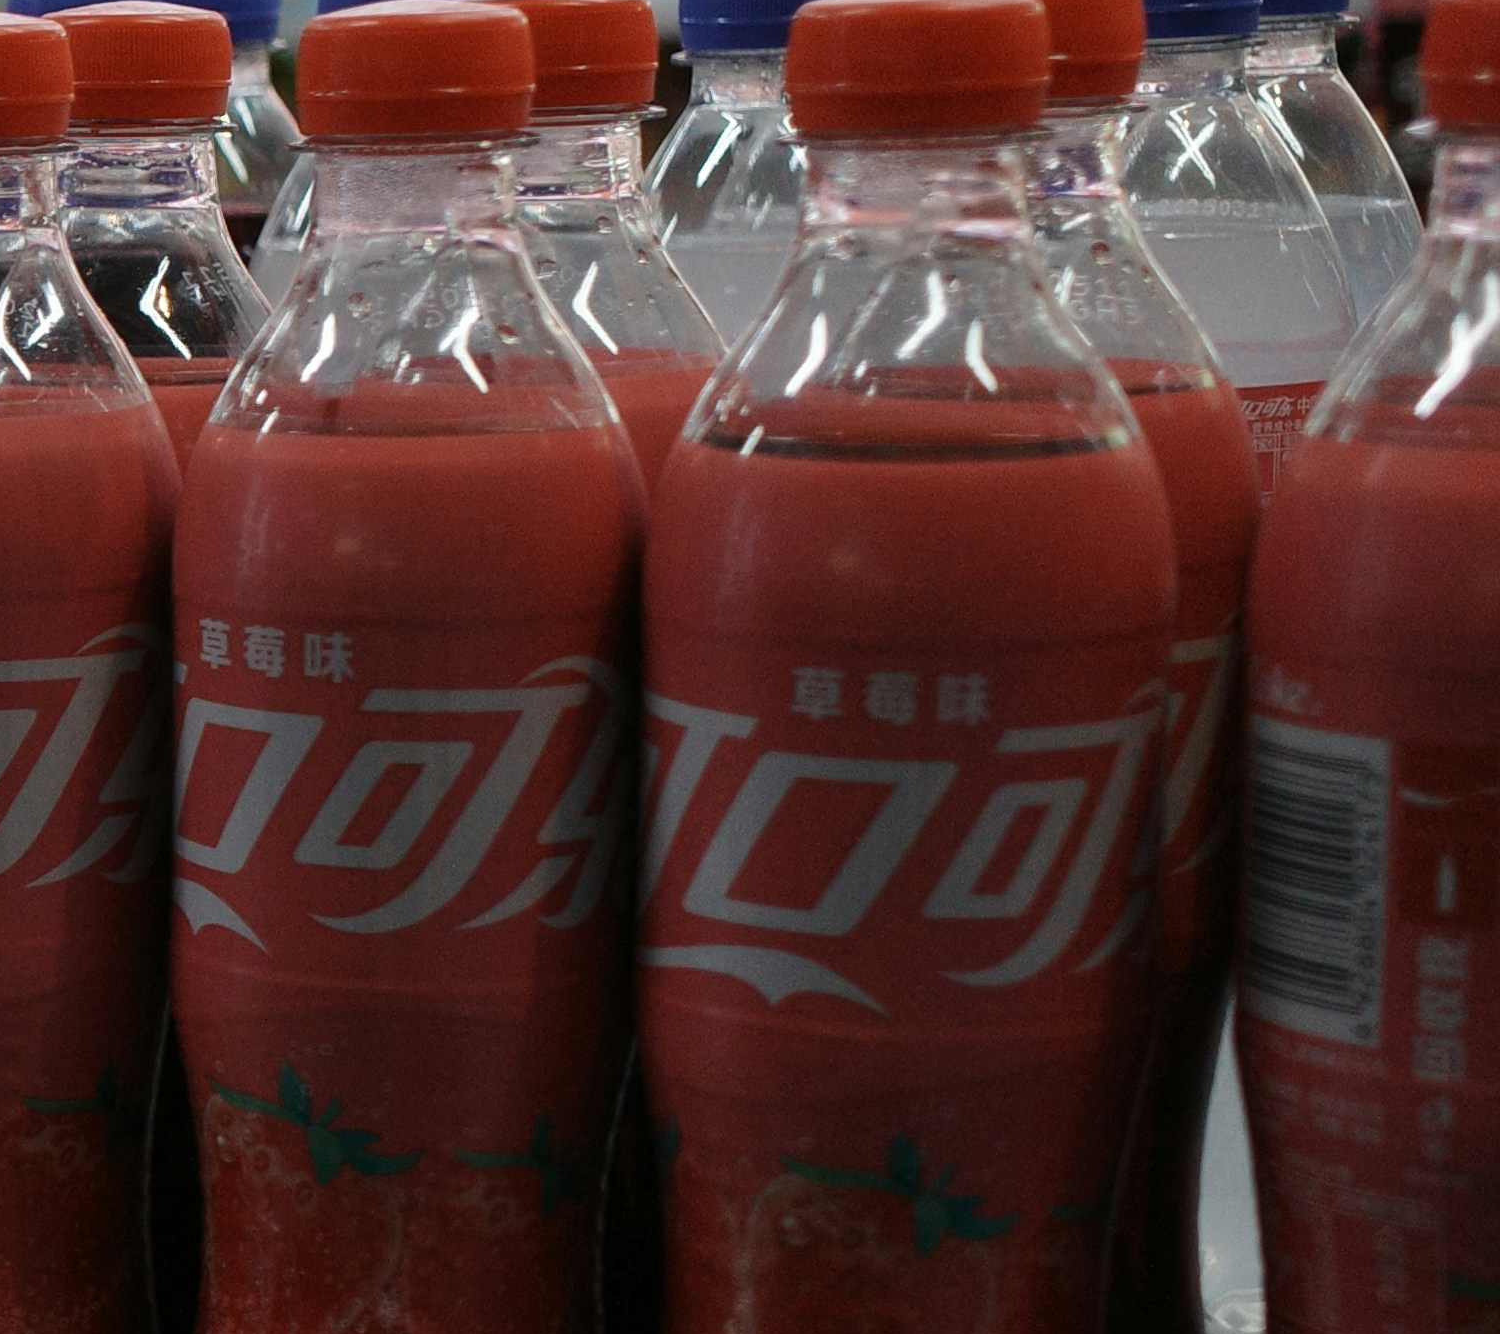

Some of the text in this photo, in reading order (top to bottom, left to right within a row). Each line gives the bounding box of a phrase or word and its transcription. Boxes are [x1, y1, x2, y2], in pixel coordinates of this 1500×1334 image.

[200, 618, 355, 684] 草莓味
[791, 666, 990, 726] 草莓味
